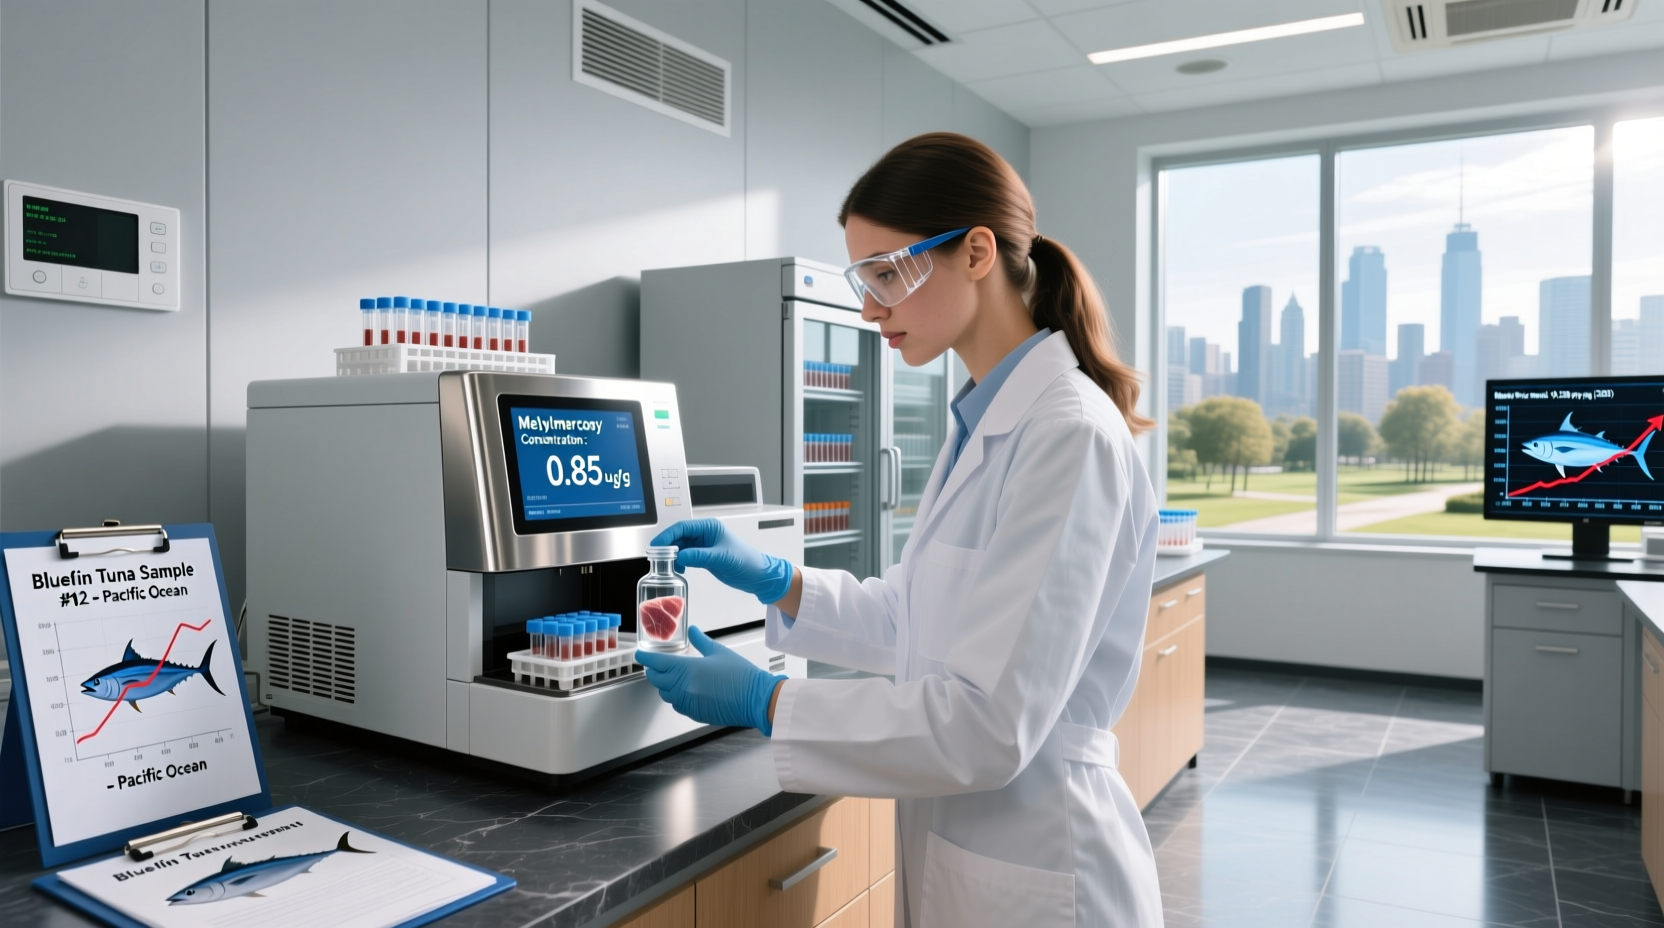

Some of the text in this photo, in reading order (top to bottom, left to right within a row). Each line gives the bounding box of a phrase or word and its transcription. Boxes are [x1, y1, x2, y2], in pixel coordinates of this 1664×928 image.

[546, 455, 603, 486] 0.85
[95, 568, 136, 583] Tuna
[139, 562, 194, 581] Sample
[148, 585, 188, 599] Ocean
[117, 767, 164, 790] Pacific
[166, 760, 208, 778] Ocean
